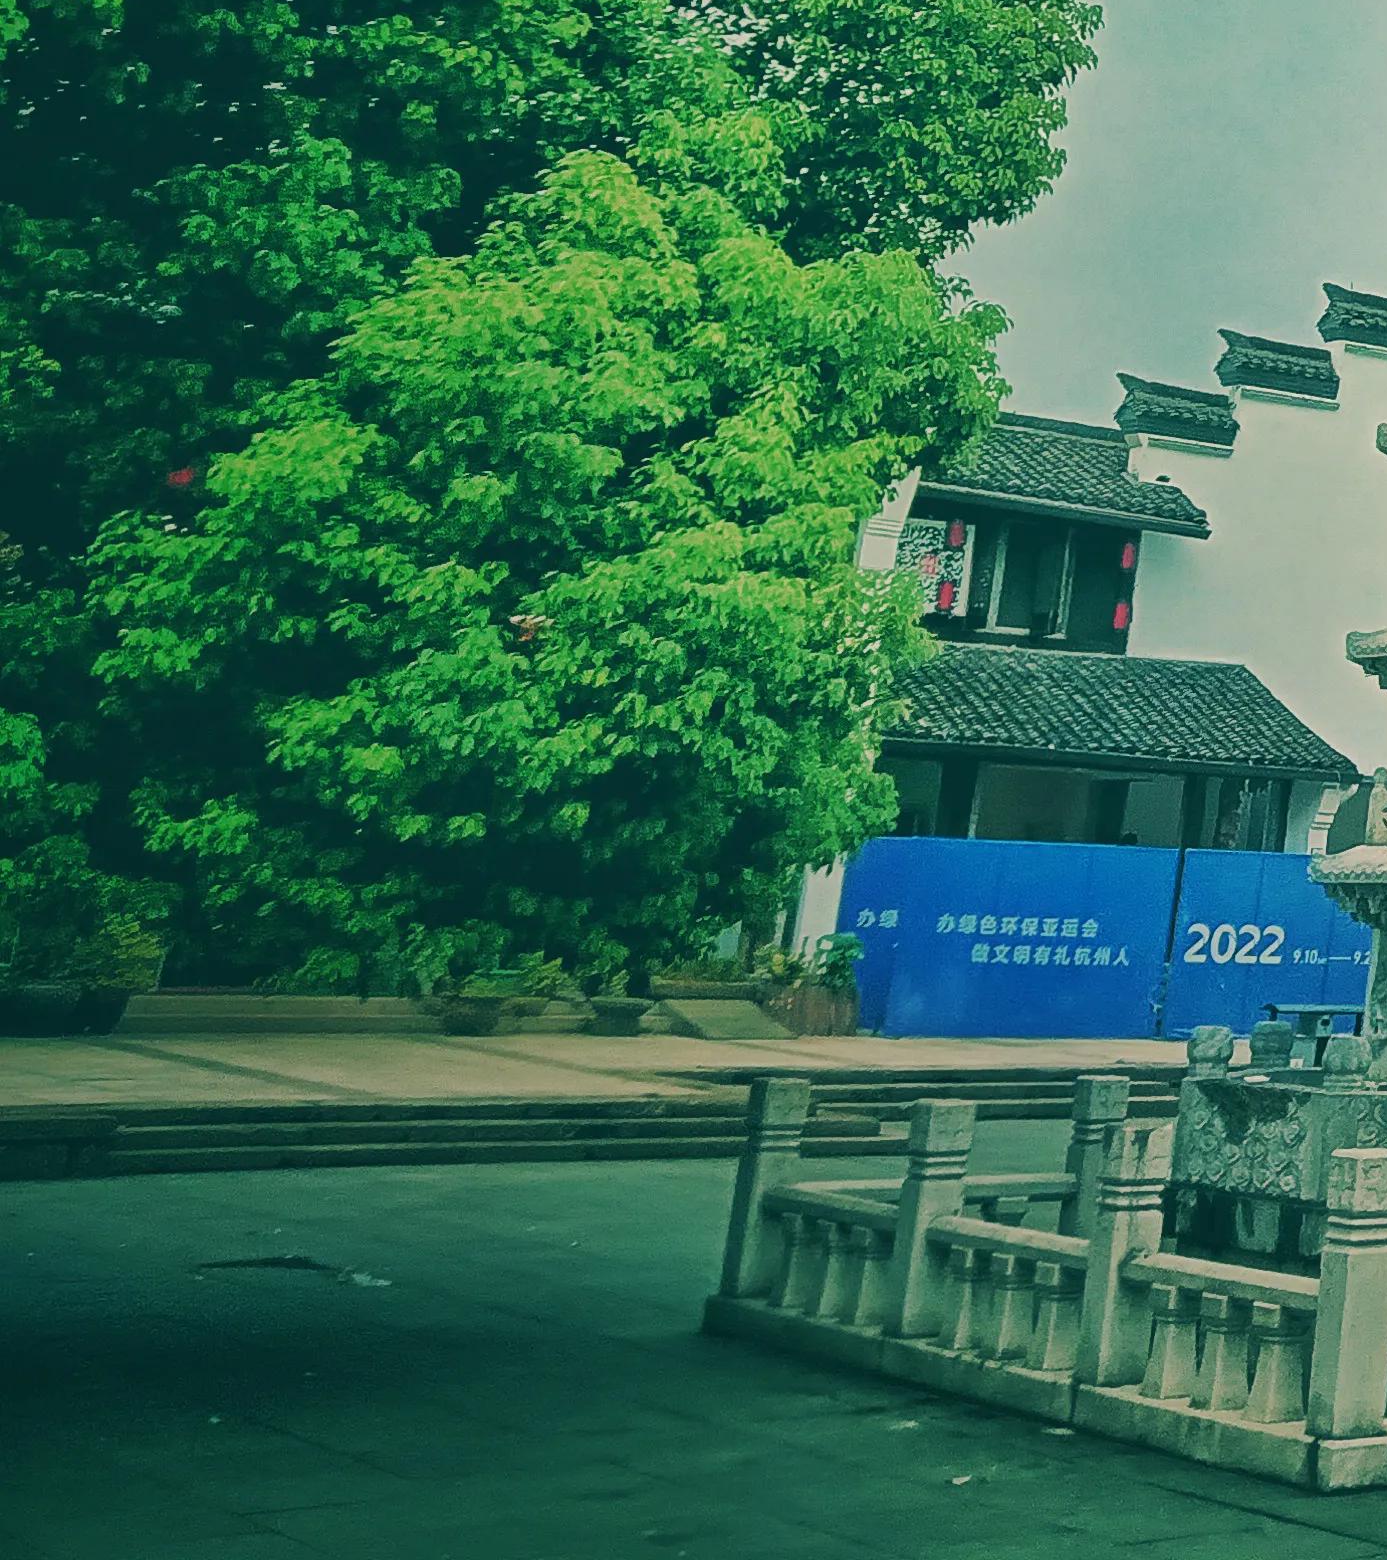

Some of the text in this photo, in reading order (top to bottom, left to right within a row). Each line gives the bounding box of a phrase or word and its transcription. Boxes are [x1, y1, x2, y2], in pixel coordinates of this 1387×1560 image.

[936, 912, 1099, 938] 办绿色环保亚运会
[970, 942, 1130, 967] 做文明有礼杭州人
[1183, 923, 1285, 965] 2022
